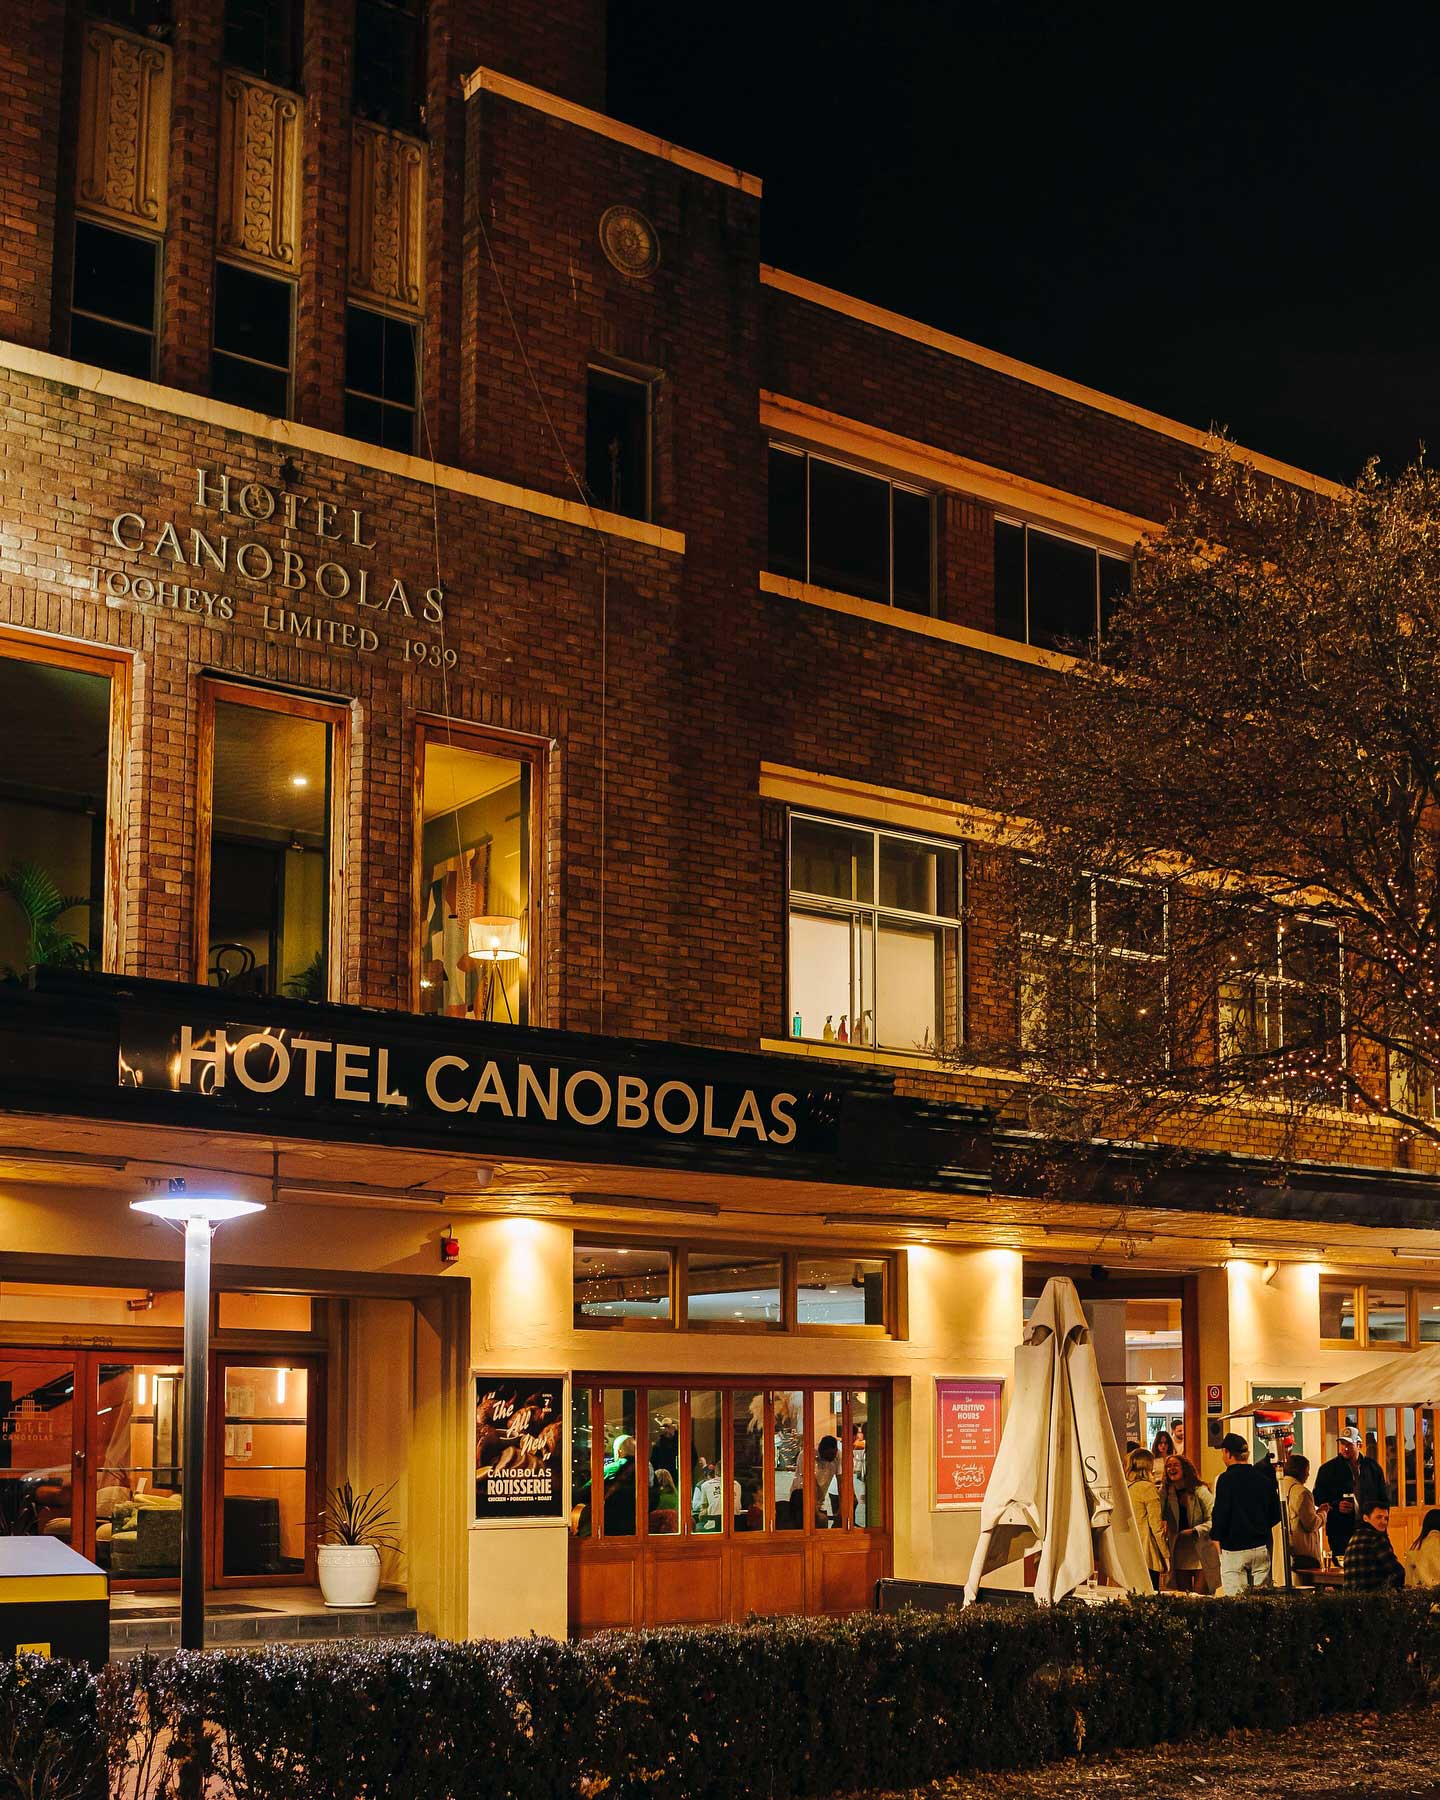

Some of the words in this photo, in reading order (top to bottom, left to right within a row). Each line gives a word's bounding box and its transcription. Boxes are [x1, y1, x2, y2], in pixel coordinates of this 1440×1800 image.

[195, 468, 377, 551] HOTEL
[112, 512, 443, 623] CANOBOLAS
[88, 566, 234, 620] TOOHEYS
[263, 604, 379, 652] LIMITED
[403, 639, 458, 670] 1939
[180, 1025, 407, 1106] HOTEL
[425, 1055, 798, 1144] CANOBOLAS
[952, 1403, 985, 1411] APERITIVO
[957, 1412, 980, 1420] HOURS
[487, 1468, 552, 1478] CANOBOLAS
[487, 1479, 552, 1495] ROTISSERIE
